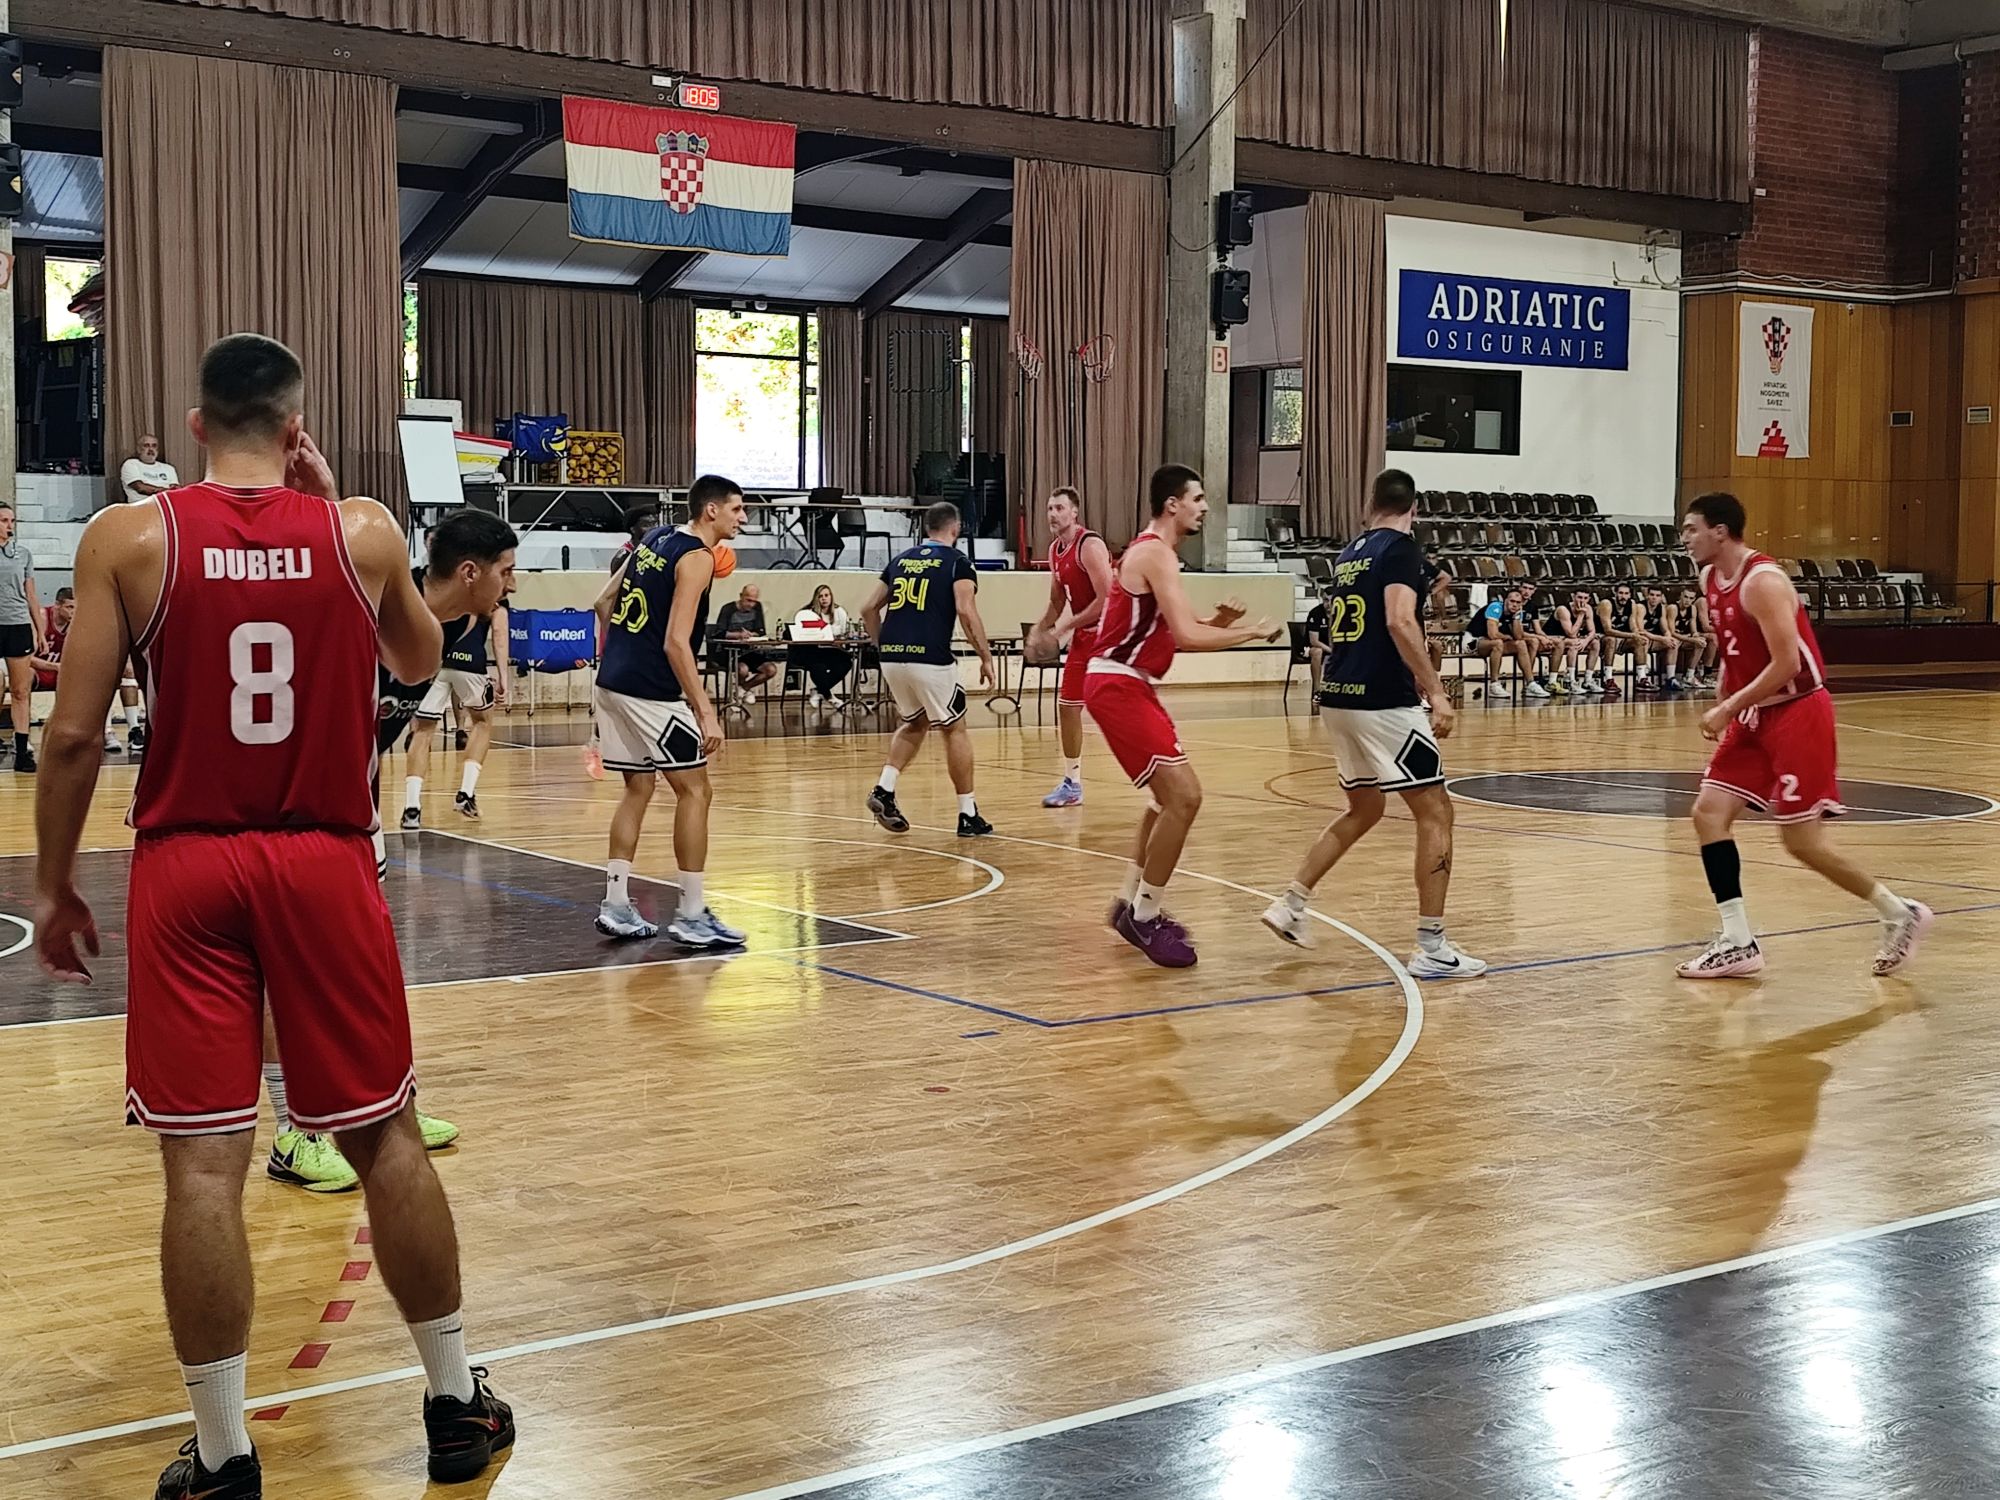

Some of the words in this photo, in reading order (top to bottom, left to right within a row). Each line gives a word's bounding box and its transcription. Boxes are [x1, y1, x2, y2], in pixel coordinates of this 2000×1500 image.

[1427, 282, 1605, 331] ADRIATIC
[1213, 347, 1226, 371] B
[1426, 328, 1604, 361] OSIGURANJE
[203, 547, 312, 581] DUBELJ
[888, 577, 930, 611] 34
[540, 629, 586, 641] molten
[1331, 594, 1366, 643] 23
[229, 622, 294, 745] 8
[1780, 774, 1802, 802] 2
